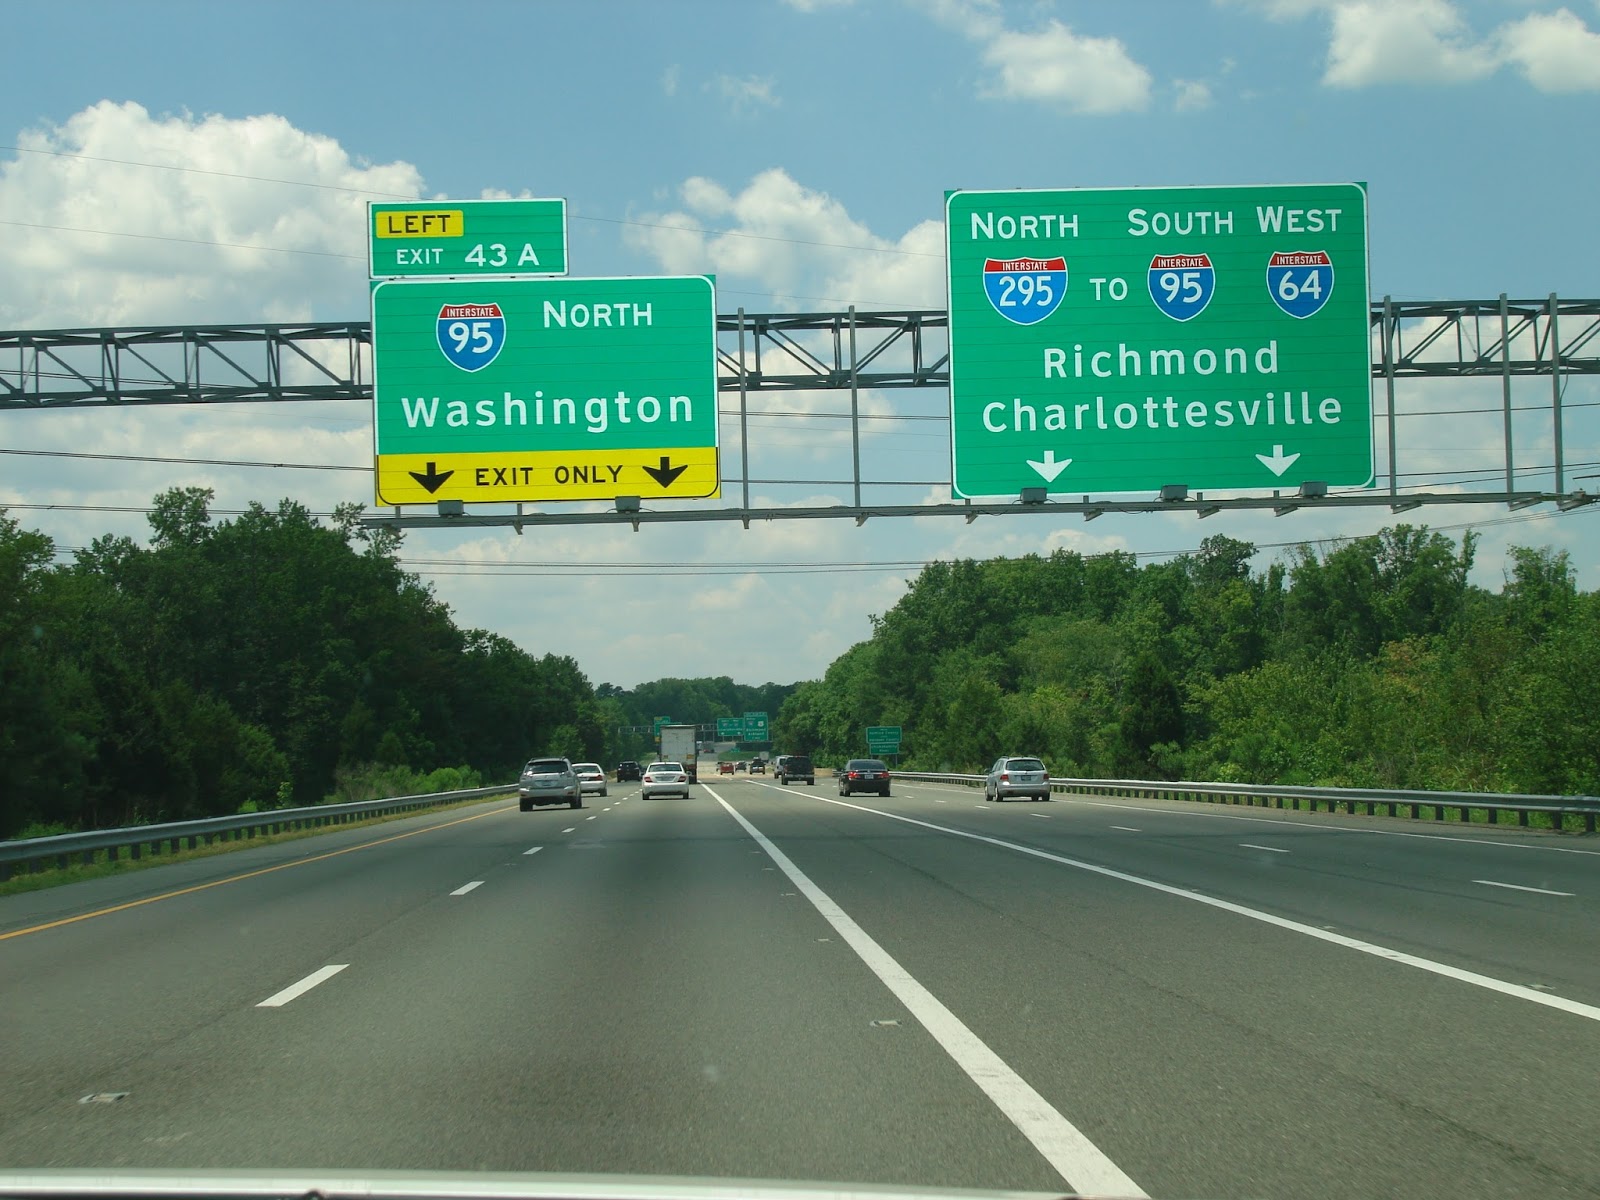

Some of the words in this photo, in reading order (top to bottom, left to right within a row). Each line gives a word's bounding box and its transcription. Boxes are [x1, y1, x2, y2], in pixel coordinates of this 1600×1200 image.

[388, 214, 450, 234] LEFT
[971, 212, 1079, 240] NORTH
[1127, 208, 1233, 236] SOUTH
[1256, 206, 1342, 233] WEST
[396, 248, 444, 265] EXIT
[1001, 261, 1049, 271] INTERSTATE
[1156, 257, 1205, 268] INTERSTATE
[1275, 255, 1323, 265] INTERSTATE
[999, 275, 1053, 307] 295
[1089, 277, 1128, 301] TO
[1160, 272, 1203, 303] 95
[1278, 270, 1322, 301] 64
[445, 307, 495, 317] INTERSTATE
[543, 300, 652, 328] NORTH
[448, 322, 493, 354] 95
[1044, 340, 1278, 379] Richmond
[402, 391, 692, 433] Washington
[982, 391, 1342, 433] Charlottesville
[475, 467, 533, 486] EXIT
[555, 465, 623, 484] ONLY
